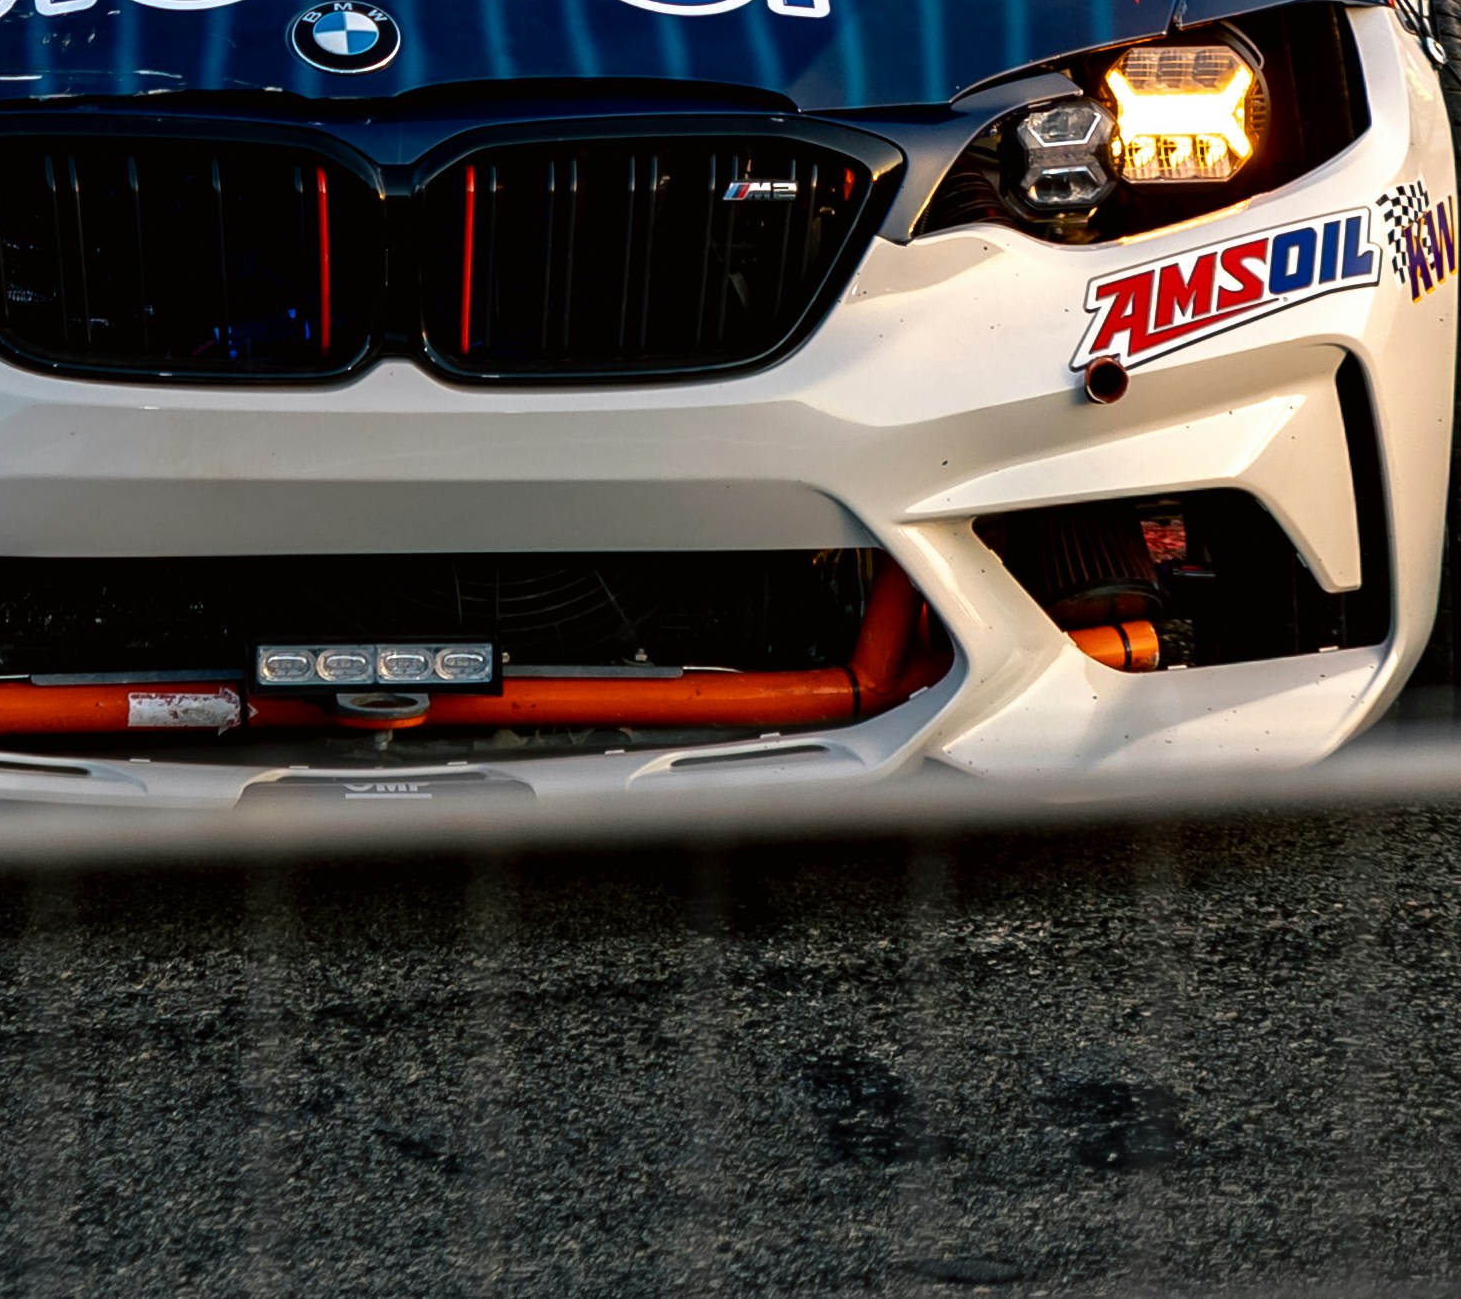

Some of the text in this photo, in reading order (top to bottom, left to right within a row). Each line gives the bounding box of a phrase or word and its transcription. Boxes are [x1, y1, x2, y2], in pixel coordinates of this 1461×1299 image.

[303, 2, 388, 23] BMW
[1089, 215, 1375, 356] AMSOIL
[1404, 195, 1458, 304] KW
